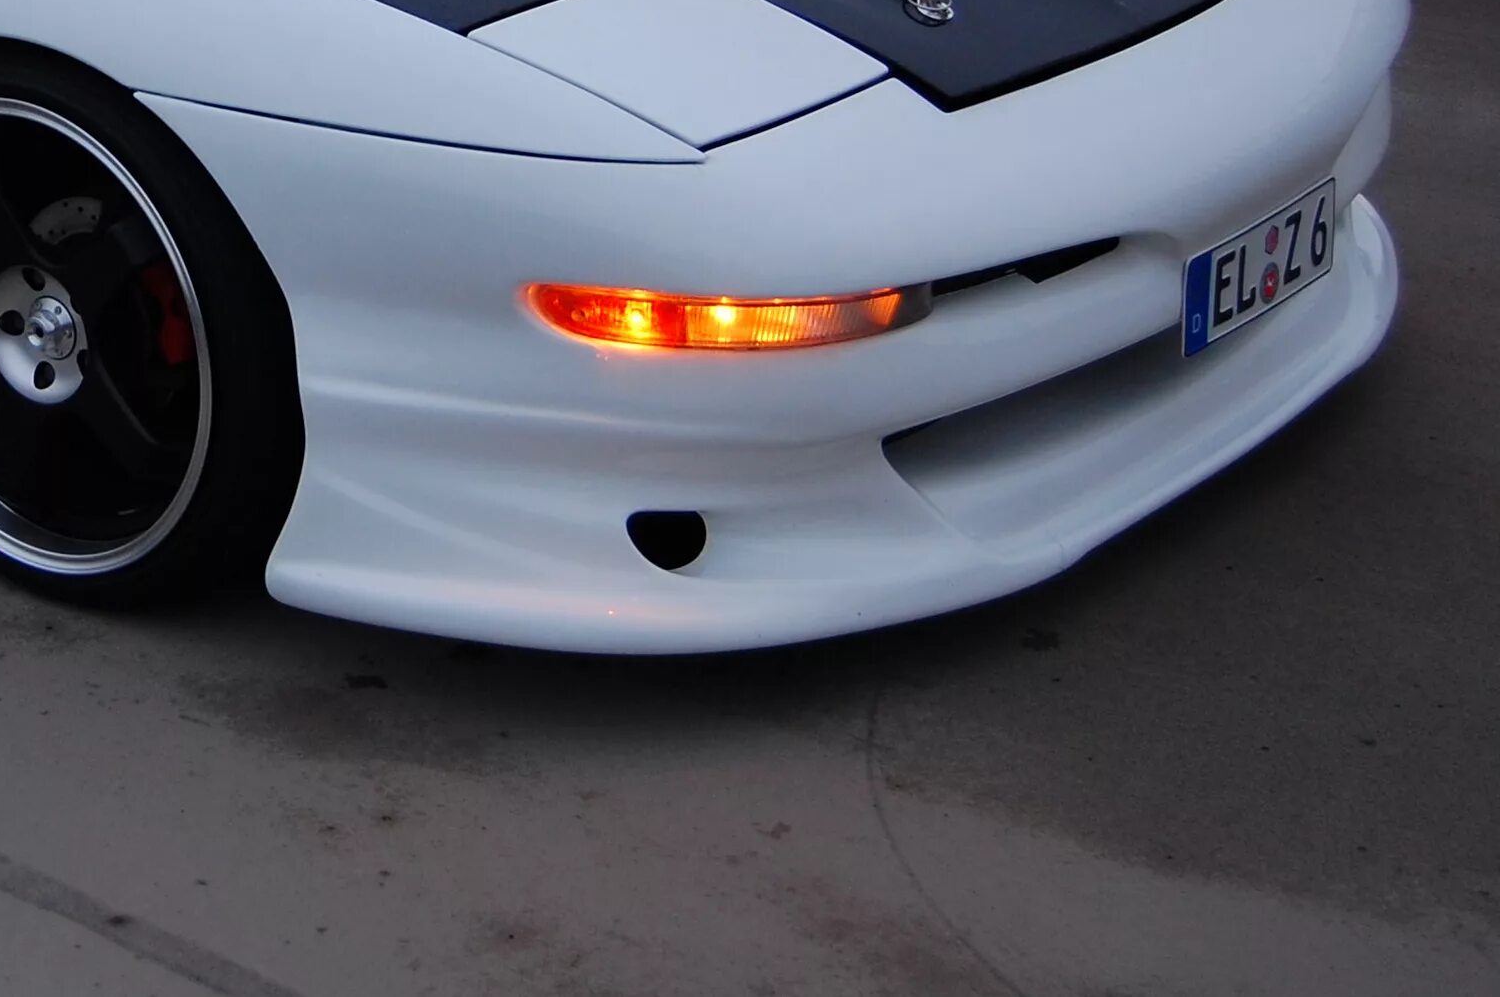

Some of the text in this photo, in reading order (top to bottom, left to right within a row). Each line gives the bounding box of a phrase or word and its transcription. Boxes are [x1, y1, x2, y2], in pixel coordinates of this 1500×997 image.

[1213, 244, 1256, 328] EL
[1283, 209, 1302, 285] Z
[1192, 313, 1201, 333] D
